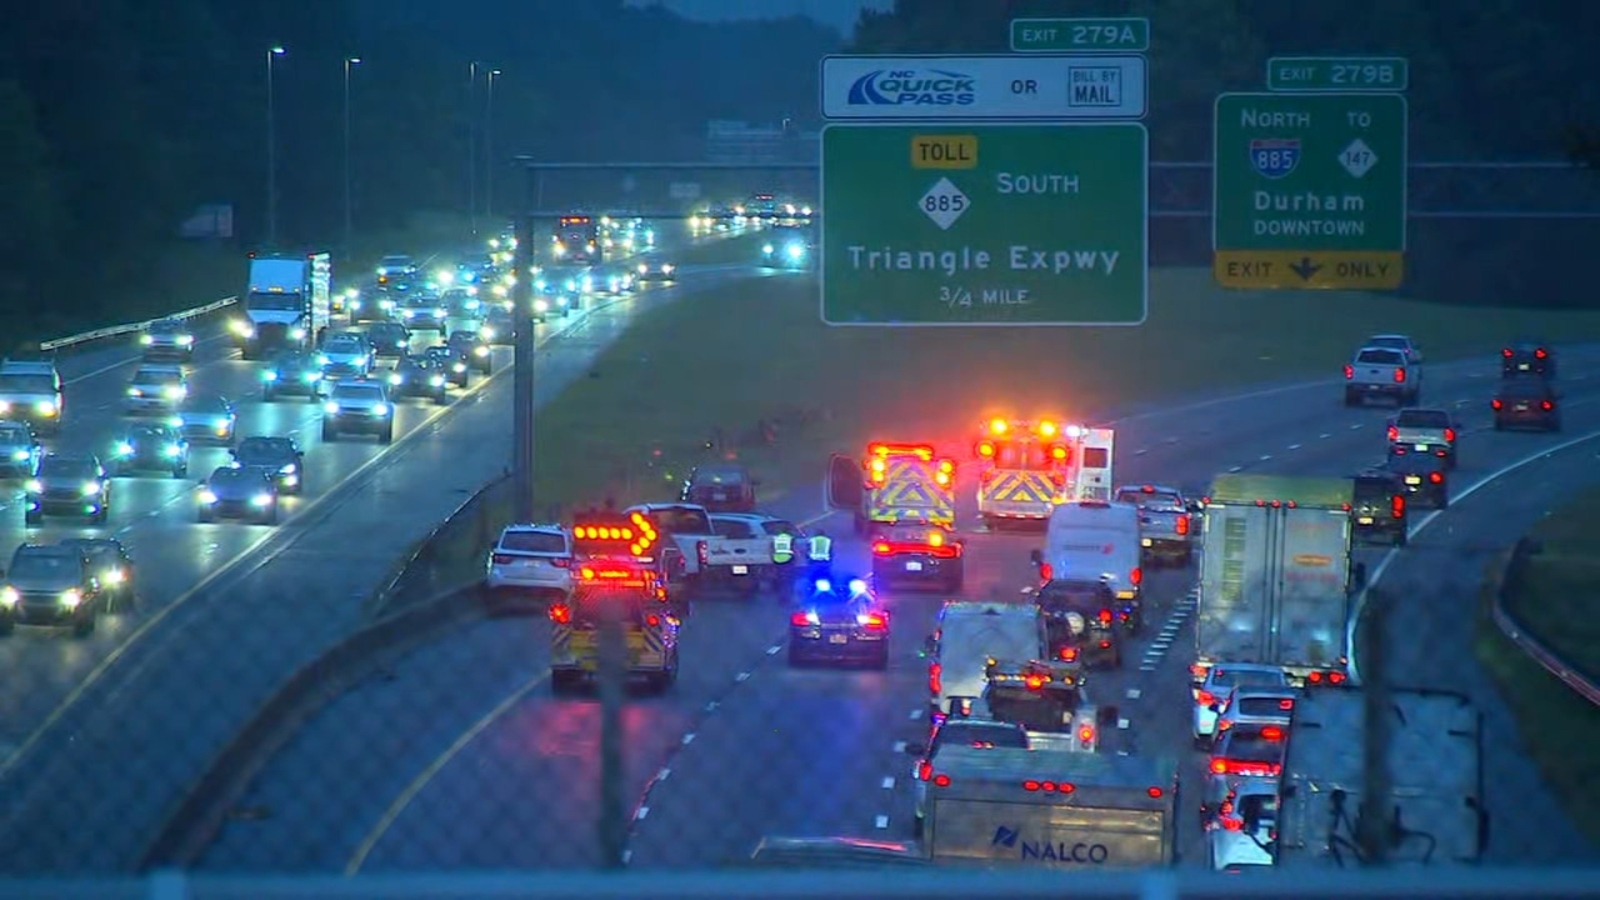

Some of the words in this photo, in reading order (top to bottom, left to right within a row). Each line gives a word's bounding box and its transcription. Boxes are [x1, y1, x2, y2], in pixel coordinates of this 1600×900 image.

[1023, 29, 1058, 41] EXIT
[1072, 26, 1136, 44] 279A
[889, 70, 915, 79] NC
[1073, 70, 1096, 82] BILL
[1102, 70, 1116, 82] BY
[1280, 67, 1315, 80] EXIT
[1332, 65, 1394, 83] 279B
[880, 79, 975, 92] QUICK
[1011, 79, 1038, 94] OR
[897, 92, 975, 106] PASS
[1075, 86, 1115, 104] MAIL
[1241, 108, 1310, 127] NORTH
[1347, 112, 1371, 127] TO
[919, 143, 970, 161] TOLL
[1258, 151, 1293, 169] 885
[1346, 152, 1371, 165] 147
[997, 173, 1079, 194] SOUTH
[925, 195, 964, 212] 885
[1254, 191, 1364, 211] Durham
[1254, 220, 1364, 235] DOWNTOWN
[849, 246, 990, 275] Triangle
[1010, 246, 1120, 275] Expwy
[1228, 262, 1272, 276] EXIT
[1337, 262, 1390, 277] ONLY
[983, 289, 1029, 304] MILE
[1022, 841, 1108, 864] NALCO
